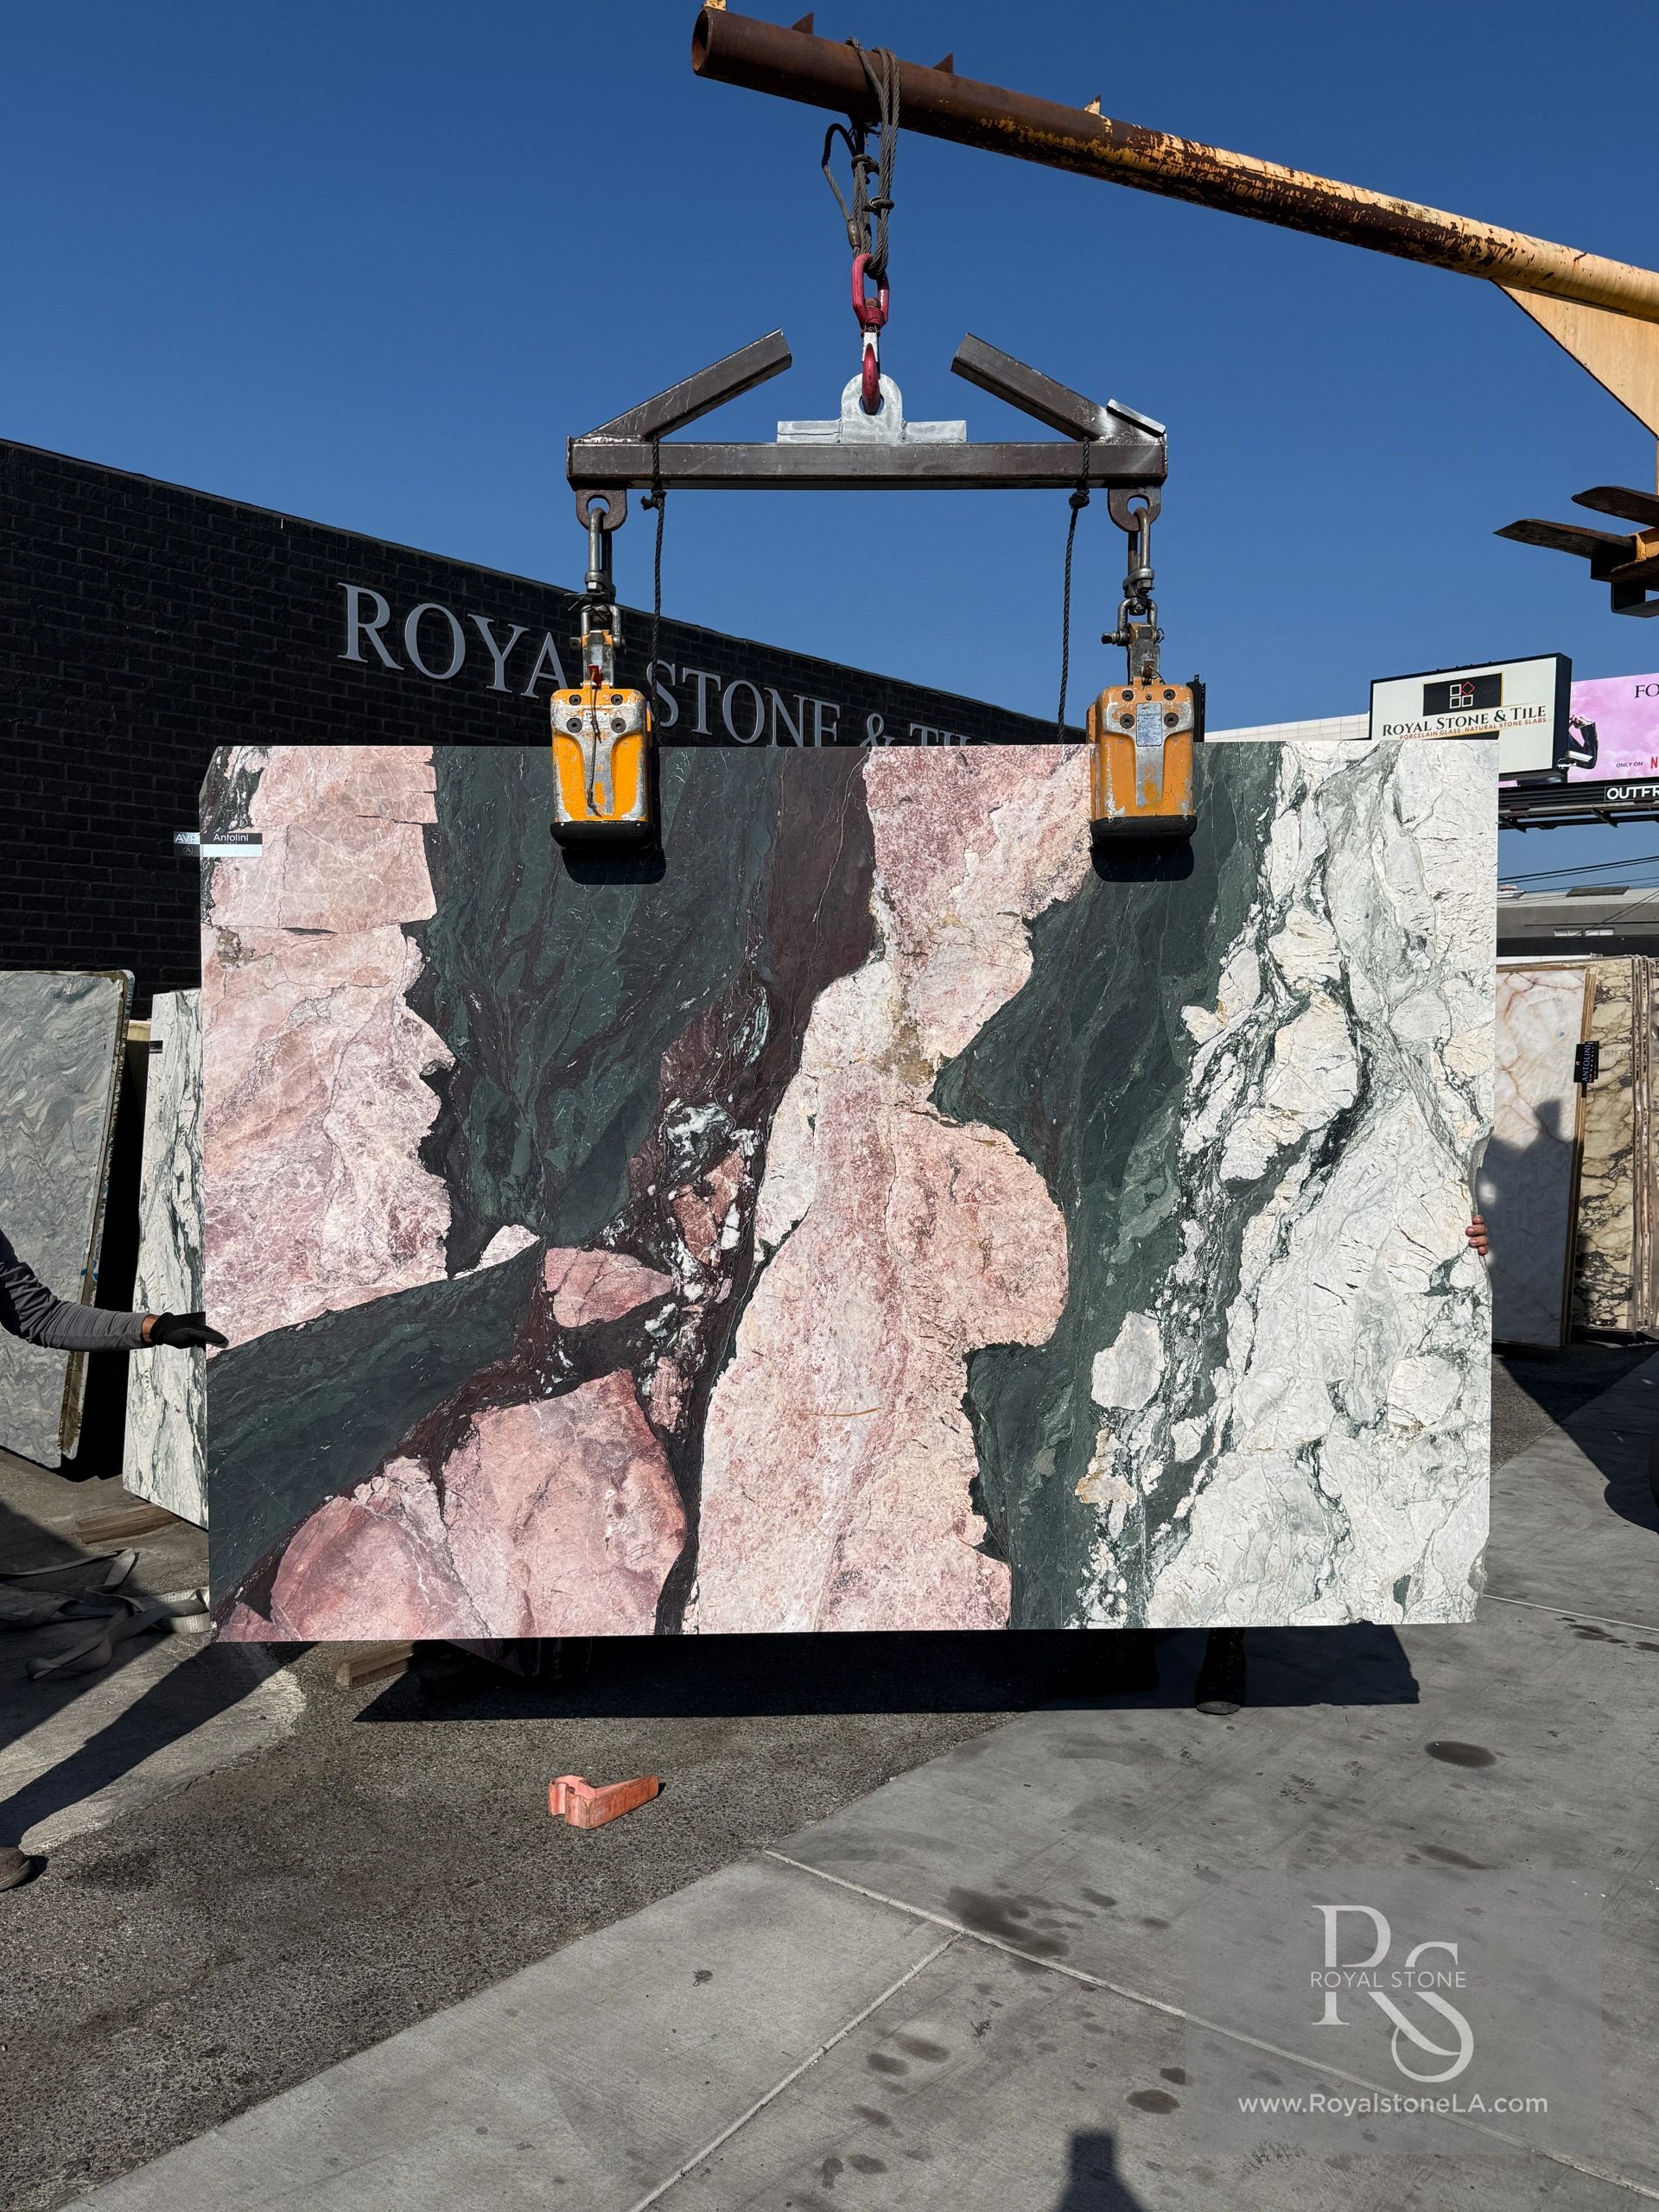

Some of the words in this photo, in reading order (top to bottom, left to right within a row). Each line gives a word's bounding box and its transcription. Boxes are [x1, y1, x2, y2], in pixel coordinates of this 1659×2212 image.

[338, 582, 569, 698] ROYA
[646, 659, 841, 747] STONE
[1382, 721, 1433, 736] ROYAL
[1493, 709, 1507, 722] &
[1400, 730, 1438, 740] PORCELAIN
[1464, 724, 1497, 733] NATURAL
[1499, 720, 1522, 728] STONE
[1524, 716, 1547, 725] SLABS
[213, 833, 249, 842] Antolini
[1581, 1045, 1591, 1082] ANTOLINI
